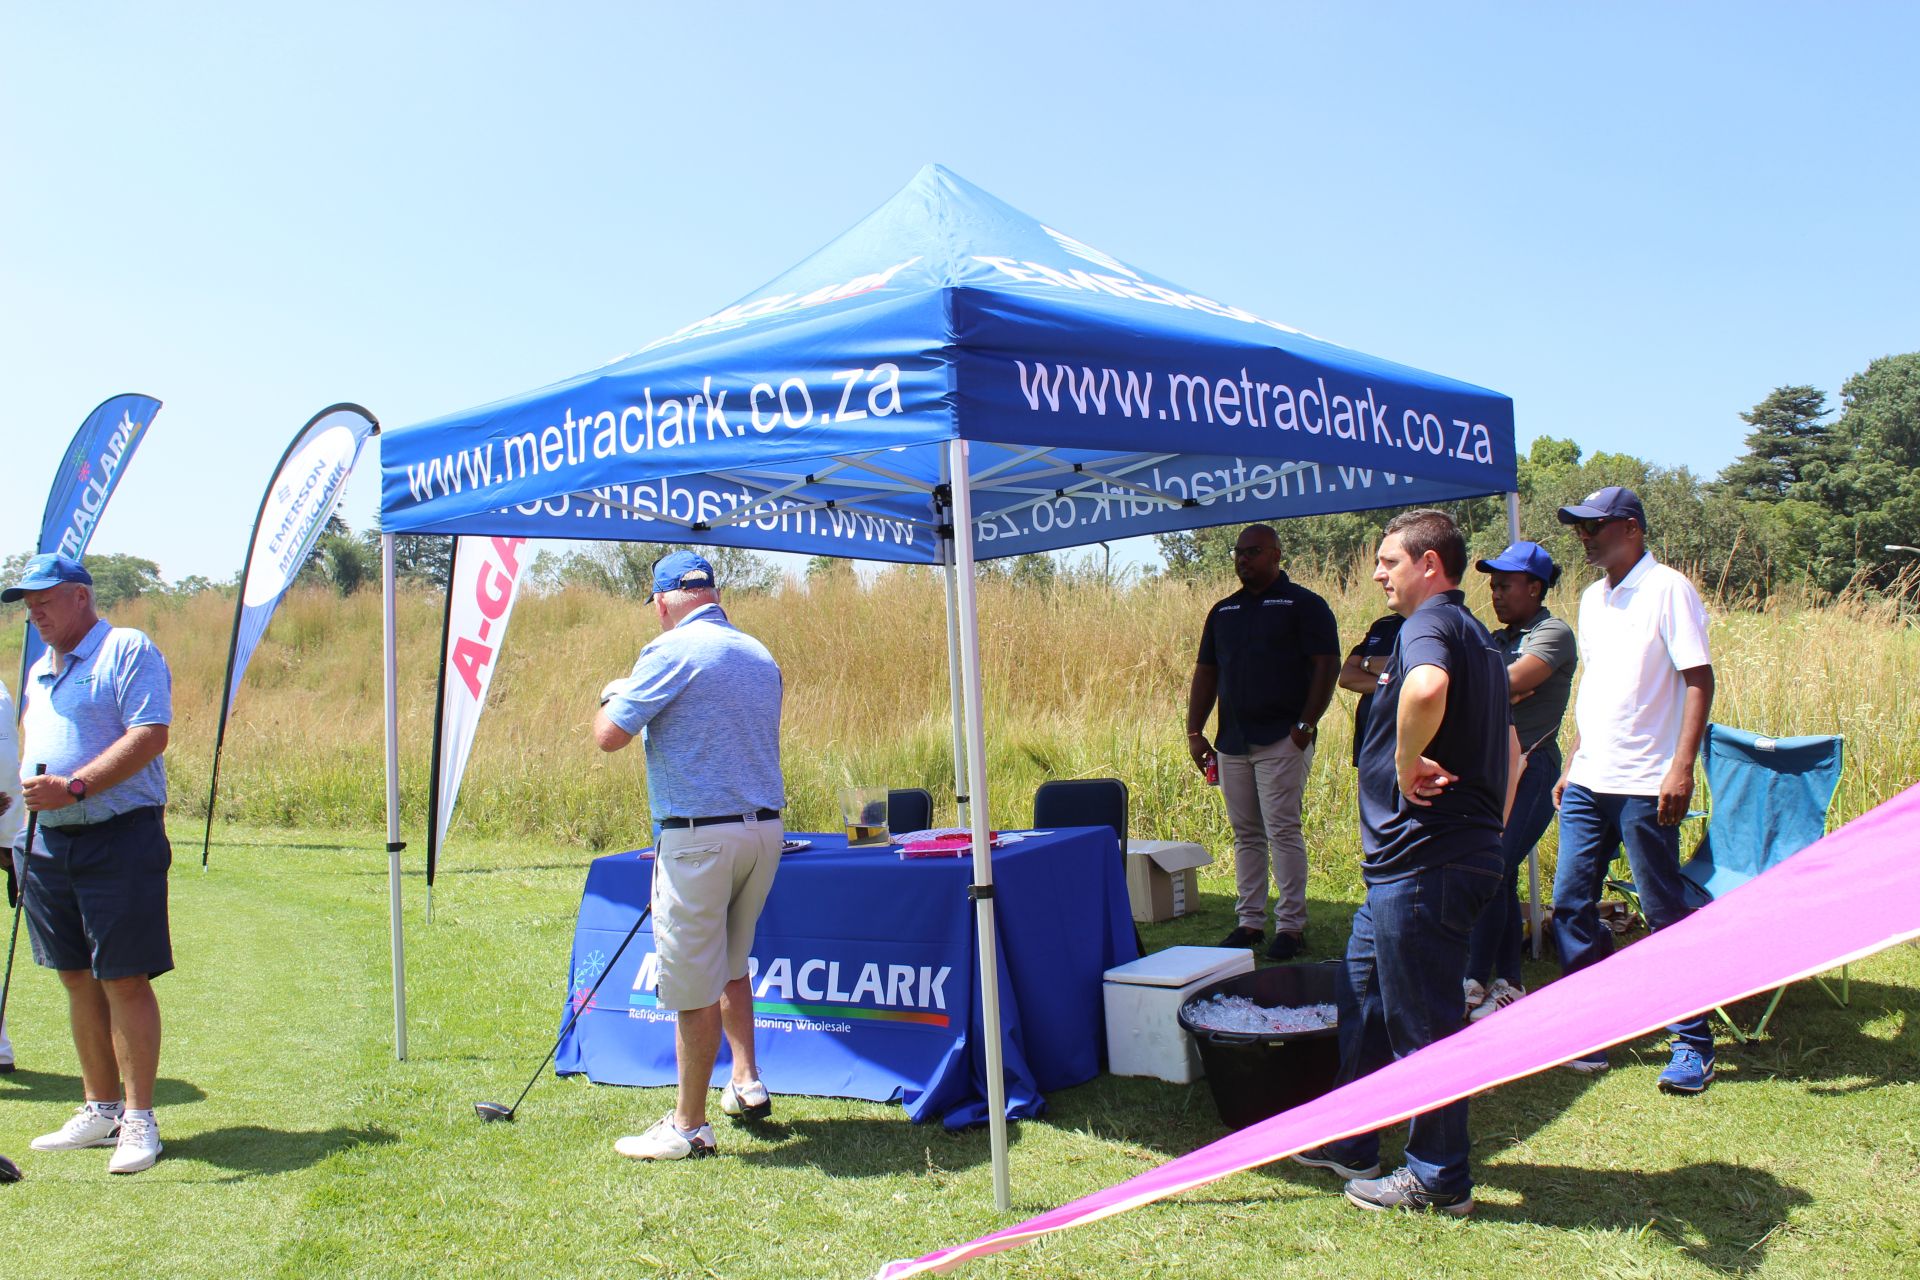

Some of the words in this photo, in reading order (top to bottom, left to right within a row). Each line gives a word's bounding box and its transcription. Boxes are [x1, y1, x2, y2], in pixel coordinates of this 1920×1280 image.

[407, 362, 904, 502] www.metraclark.co.za
[1014, 360, 1493, 465] www.metraclark.co.za
[56, 409, 135, 562] TRACLARK
[268, 459, 327, 555] EMERSON
[279, 460, 347, 575] METRACLARK
[452, 537, 527, 702] A-GA
[628, 1008, 679, 1023] Refrigerati
[795, 1018, 852, 1033] Wholesale
[632, 952, 951, 1009] MACLARK
